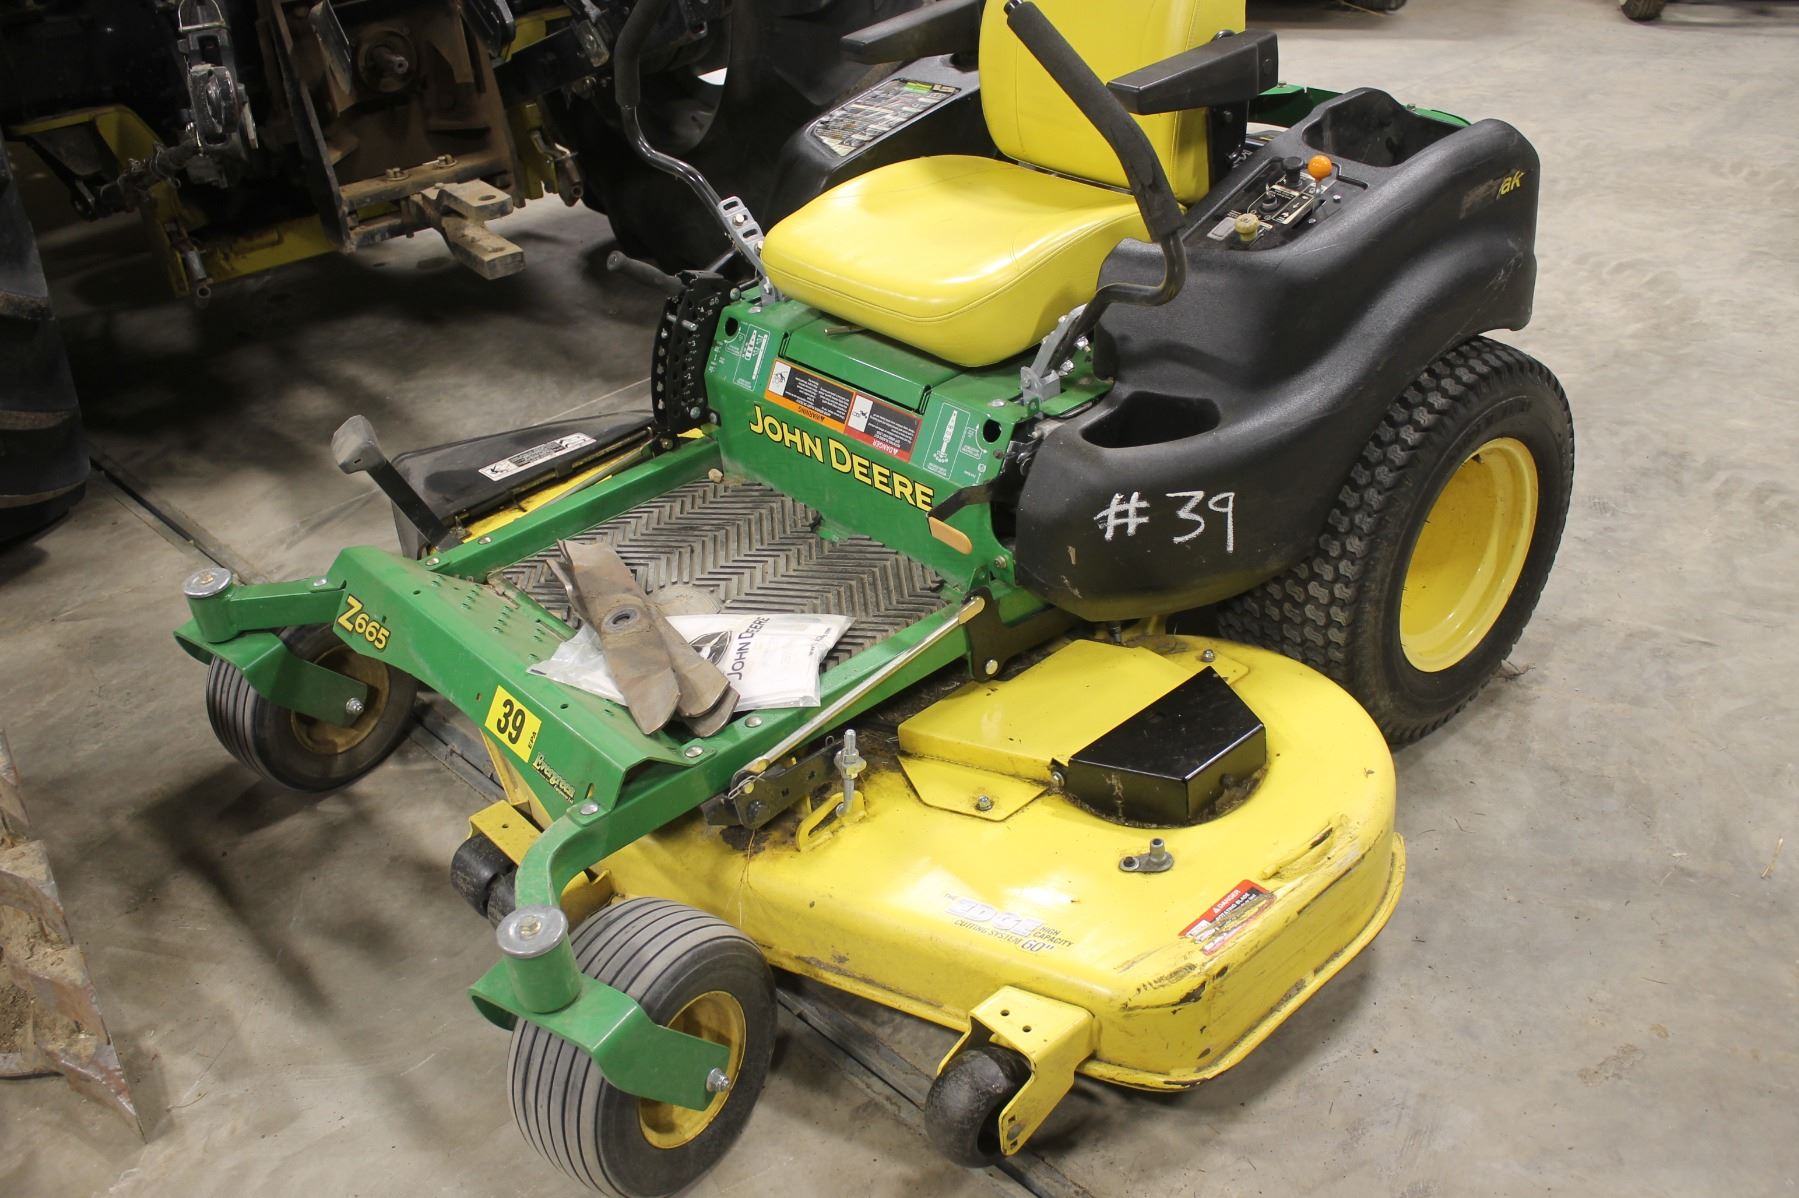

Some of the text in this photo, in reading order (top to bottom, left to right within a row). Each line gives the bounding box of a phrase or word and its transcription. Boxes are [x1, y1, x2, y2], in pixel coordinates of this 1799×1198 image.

[750, 404, 825, 463] JOHN
[829, 437, 934, 513] DEERE
[872, 439, 894, 454] DANGER
[1166, 490, 1235, 554] 39
[337, 593, 391, 651] Z665
[727, 616, 770, 681] JOHN DEERE
[497, 699, 526, 744] 39
[1218, 888, 1241, 909] DANGER
[954, 919, 988, 934] CUTTING
[988, 930, 1023, 945] SYSTEM
[1033, 931, 1075, 948] CAPACITY
[1040, 926, 1061, 936] HIGH
